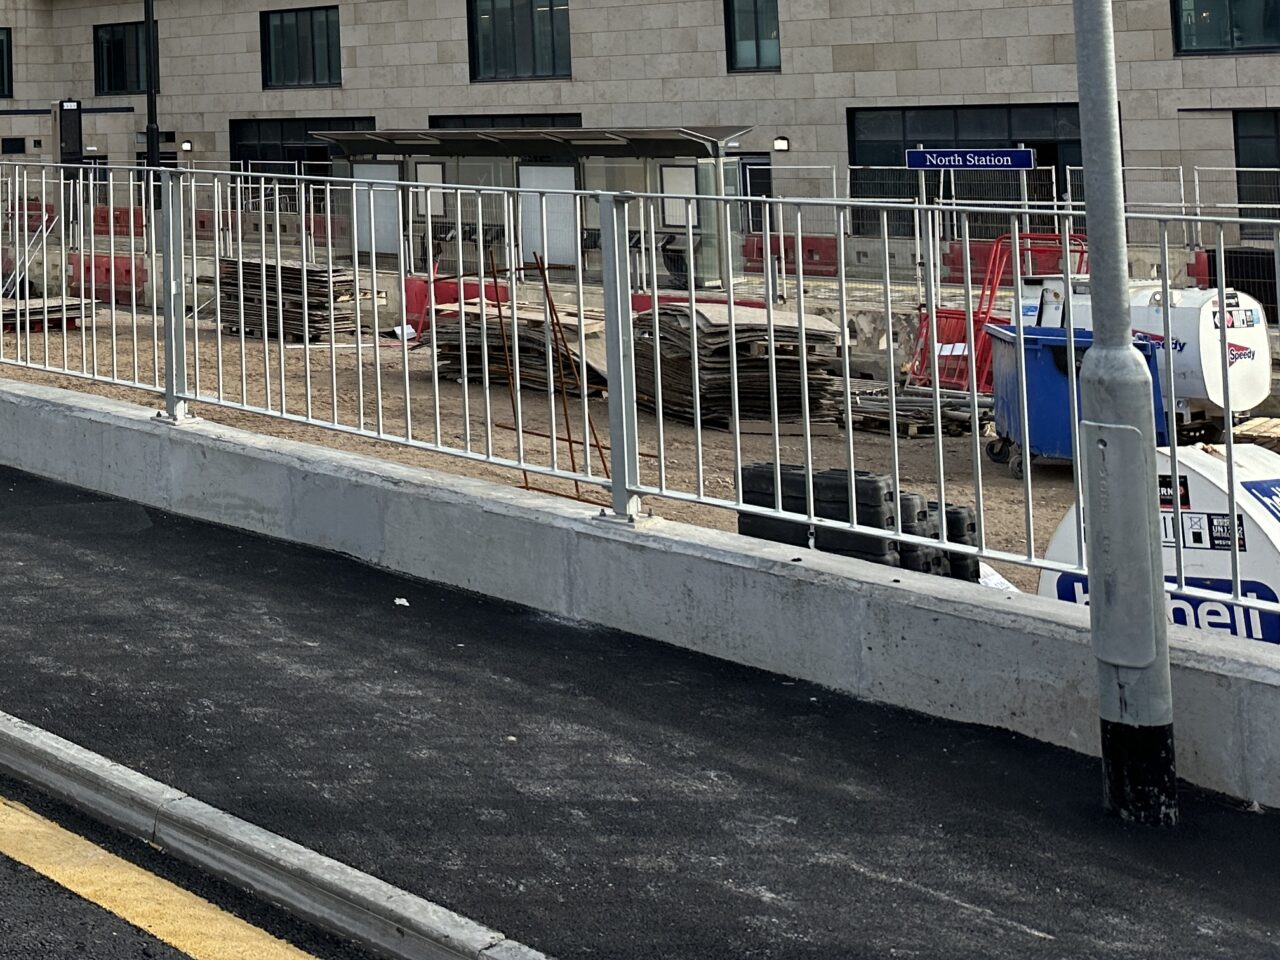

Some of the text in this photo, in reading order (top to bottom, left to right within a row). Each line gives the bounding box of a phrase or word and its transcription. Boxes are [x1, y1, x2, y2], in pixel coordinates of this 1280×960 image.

[925, 152, 1012, 166] North Station
[1229, 346, 1256, 362] Speedy
